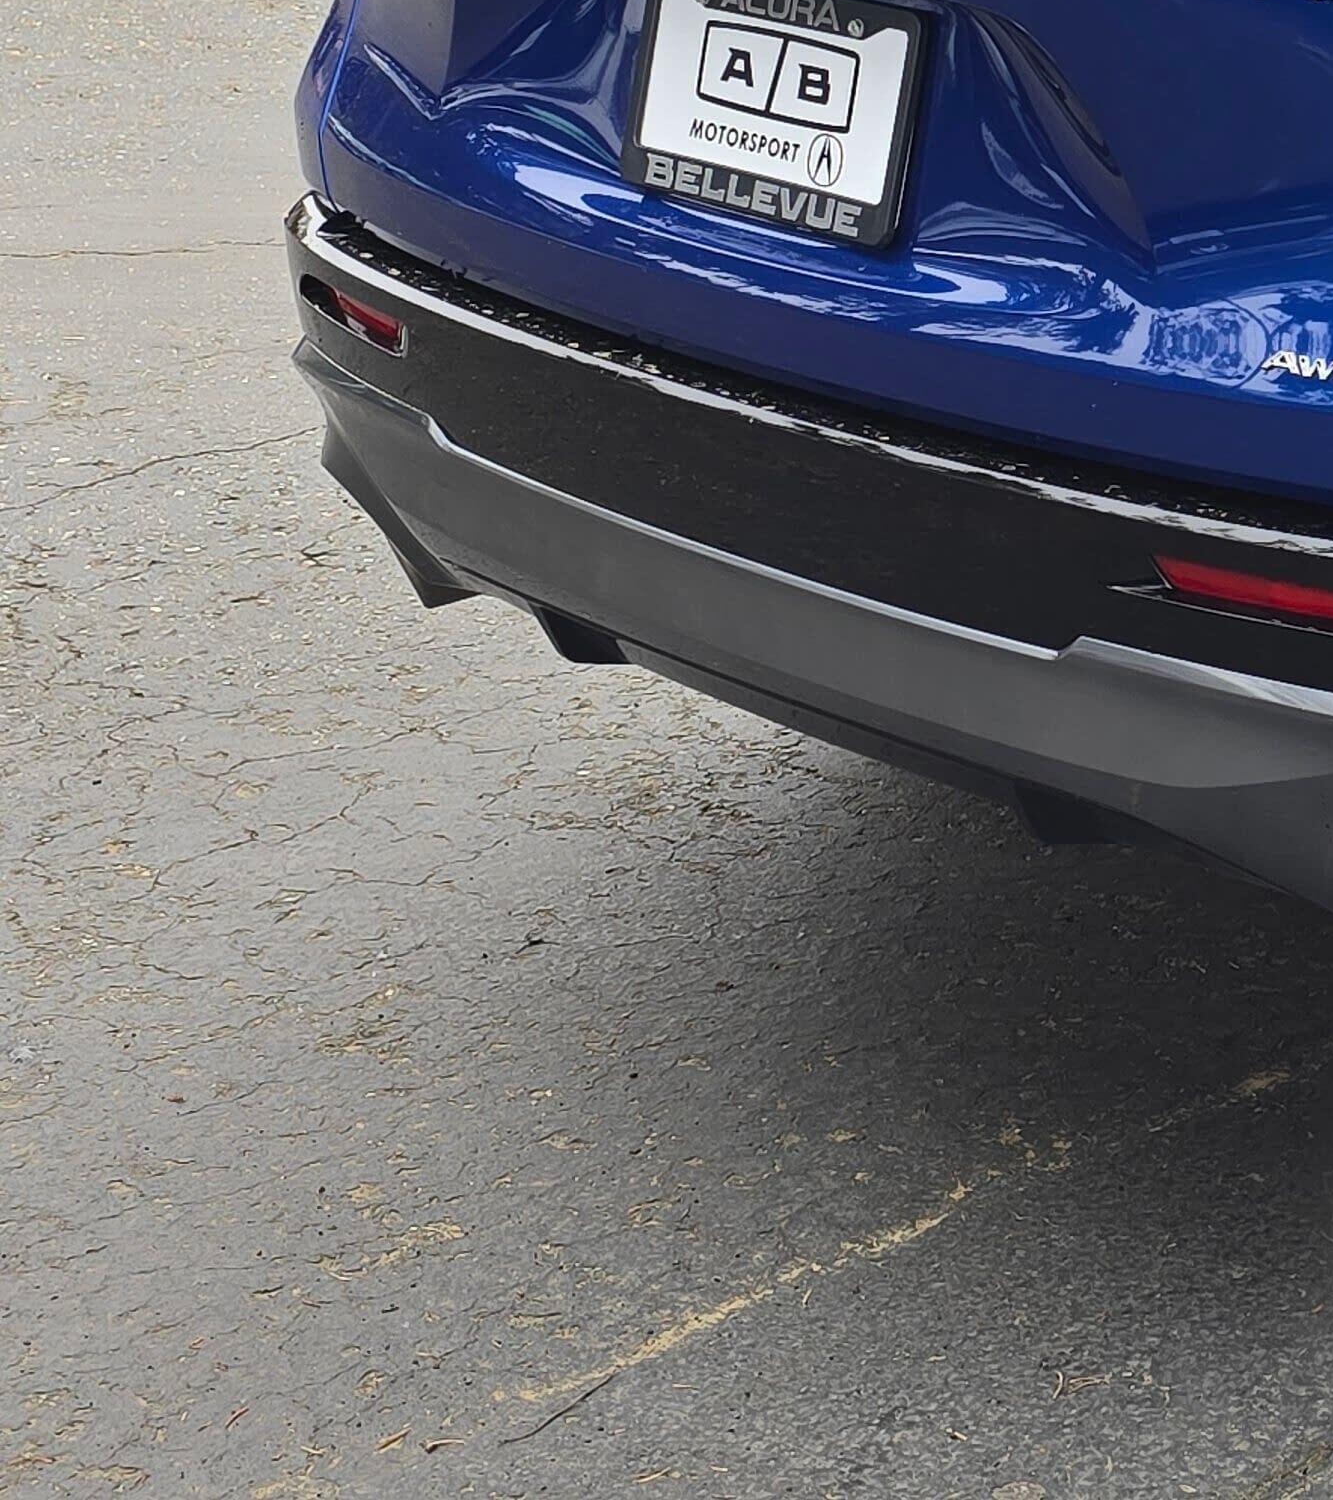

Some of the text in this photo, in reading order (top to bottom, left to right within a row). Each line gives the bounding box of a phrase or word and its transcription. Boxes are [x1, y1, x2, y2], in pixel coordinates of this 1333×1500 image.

[720, 47, 831, 105] A B
[688, 118, 801, 163] MOTORSPORT
[644, 153, 863, 238] BELLEVUE
